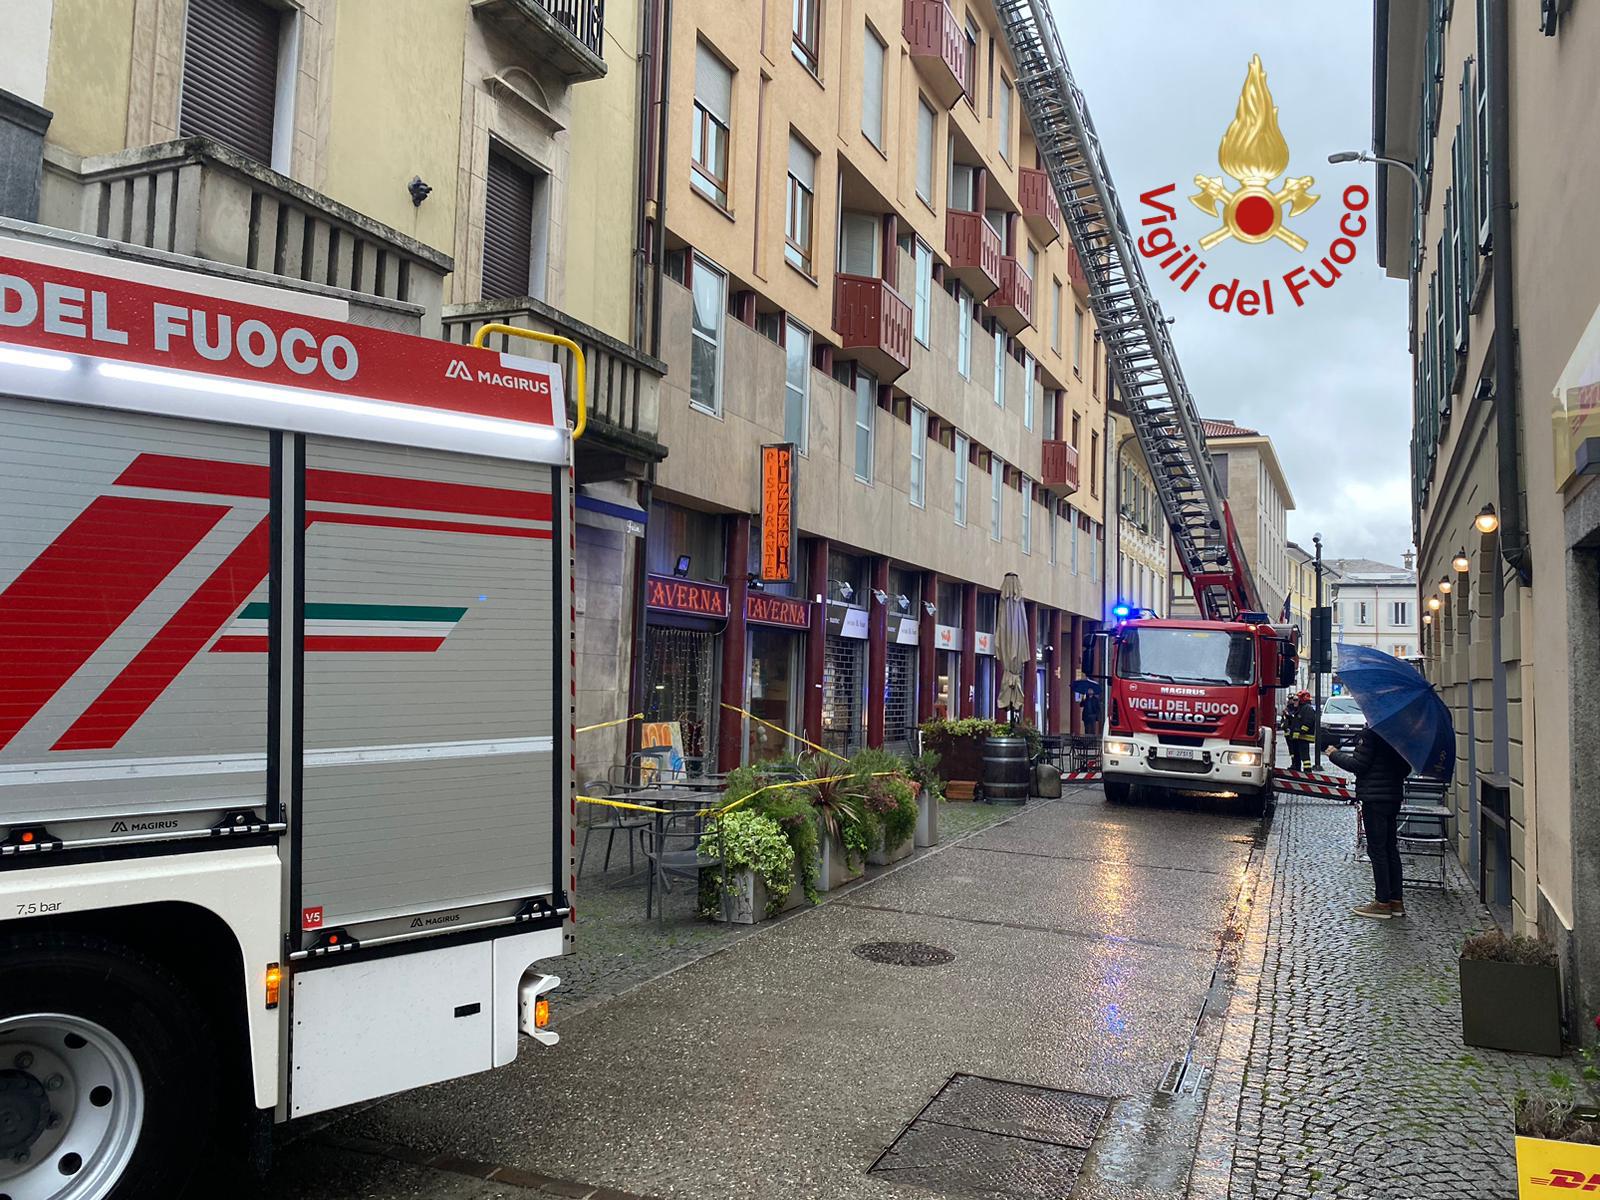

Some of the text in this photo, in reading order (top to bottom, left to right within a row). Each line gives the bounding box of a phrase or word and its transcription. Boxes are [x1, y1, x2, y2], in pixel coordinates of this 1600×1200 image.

[0, 274, 360, 382] DEL FUOCO
[477, 369, 550, 395] MAGIRUS
[764, 451, 776, 578] RISTORANTE
[777, 450, 790, 579] PIZZERIA
[747, 596, 806, 624] TAVERNA
[1160, 687, 1206, 696] MAGIRUS
[1128, 697, 1239, 716] VIGILI DEL FUOCO
[1158, 711, 1205, 723] IVECO
[131, 820, 179, 832] MAGIRUS
[16, 901, 62, 915] 7,5 bar
[305, 912, 321, 924] V5
[425, 914, 460, 926] MAGIRUS
